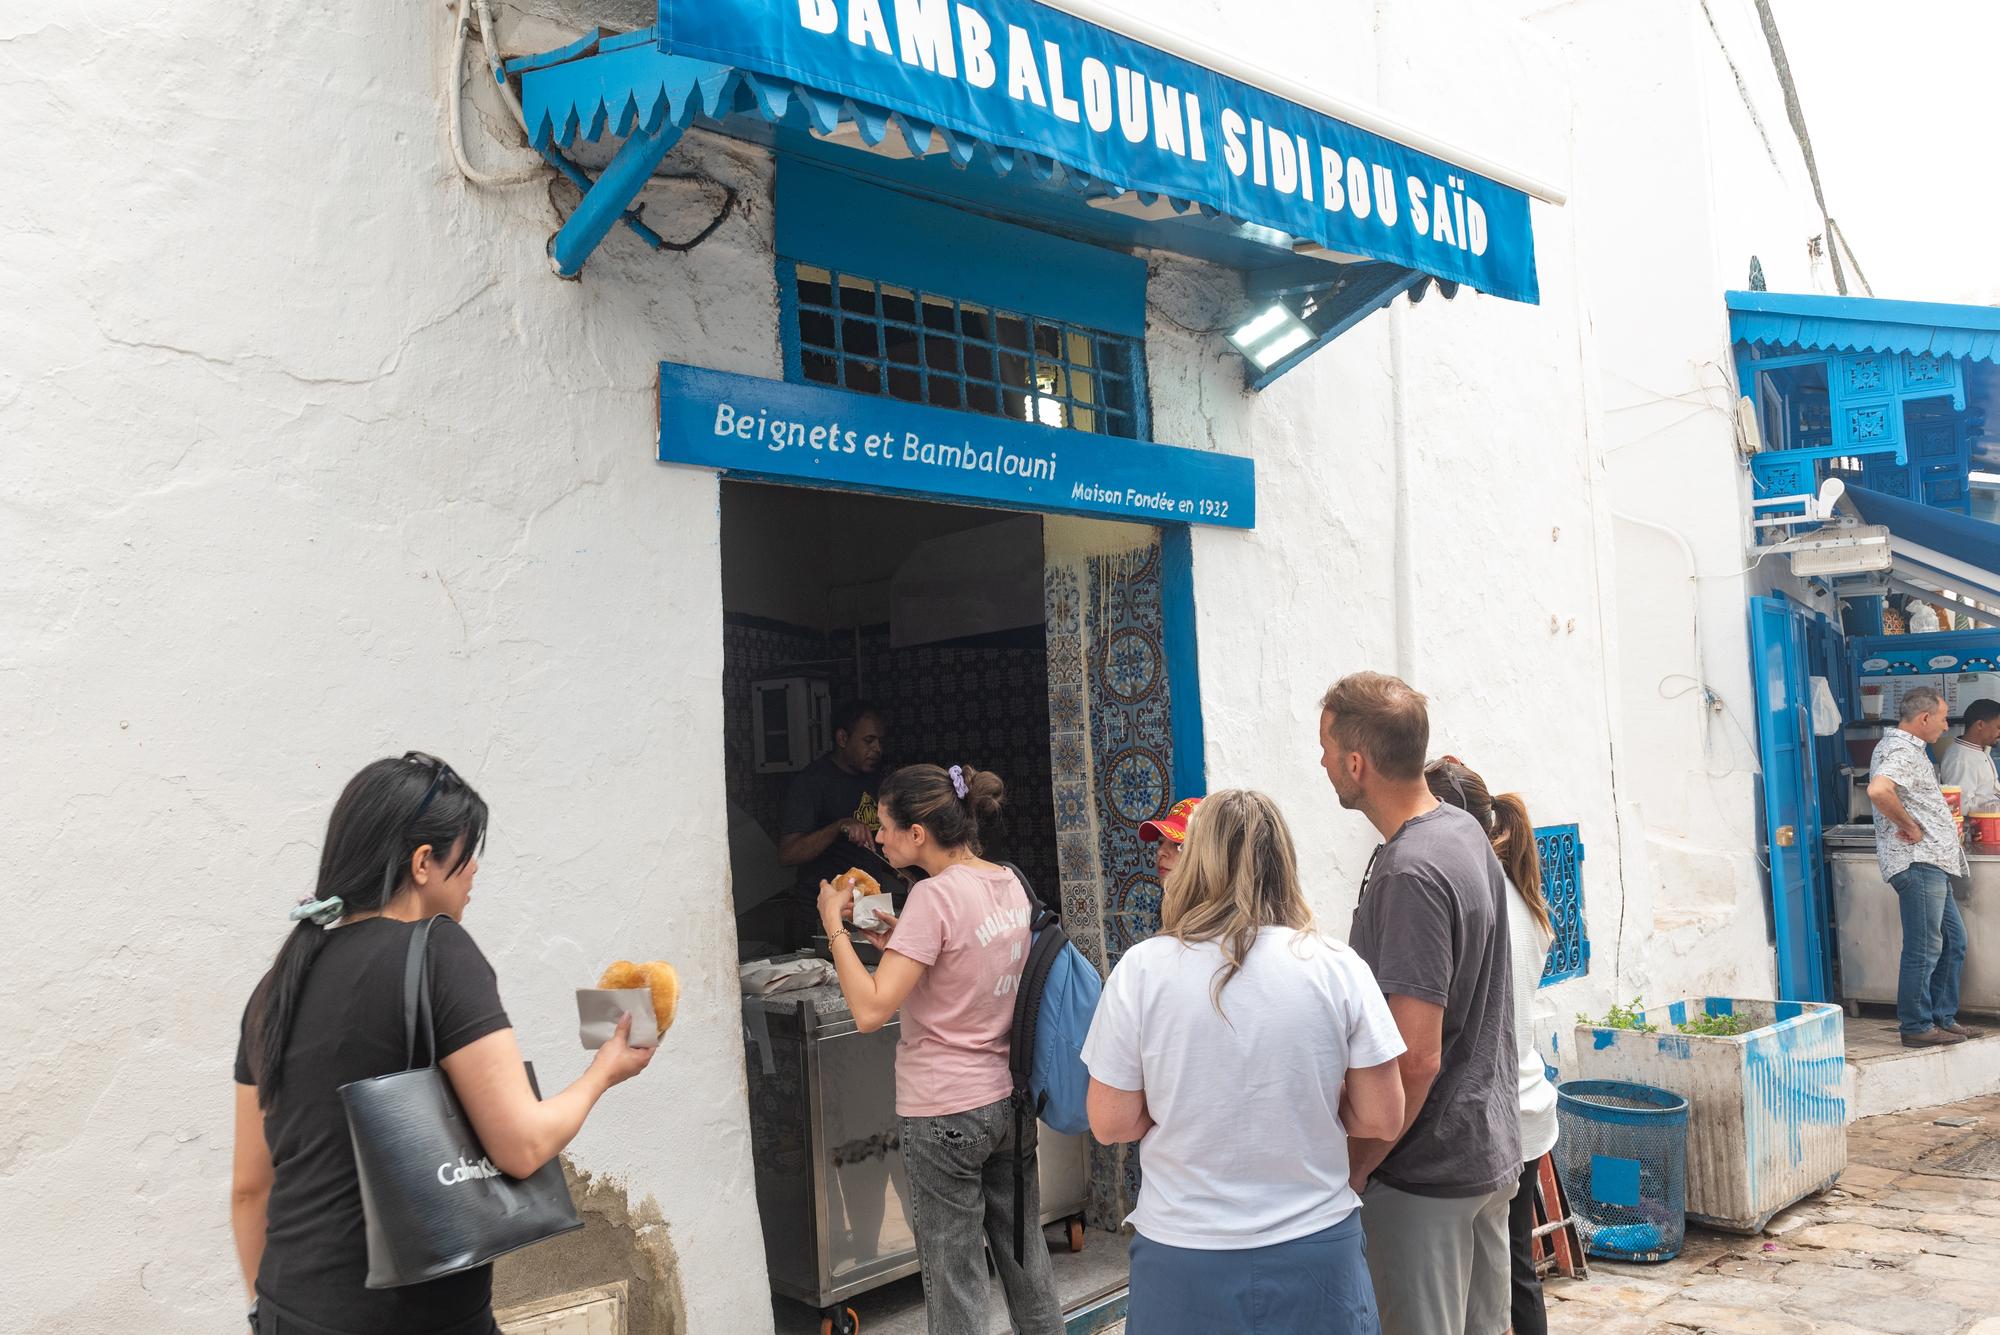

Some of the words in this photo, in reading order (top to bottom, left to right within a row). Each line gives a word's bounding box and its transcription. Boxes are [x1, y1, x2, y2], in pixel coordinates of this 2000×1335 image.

[1221, 108, 1314, 202] SIDI
[1320, 146, 1398, 227] BOU
[1407, 176, 1488, 257] SAÏD
[714, 403, 857, 454] Beignets
[864, 434, 895, 459] et
[903, 432, 1057, 481] Bambalouni
[1071, 481, 1122, 506] Maison
[1126, 488, 1175, 513] Fondée
[1178, 499, 1194, 513] en
[1198, 499, 1230, 518] 1932
[1010, 940, 1022, 961] IN
